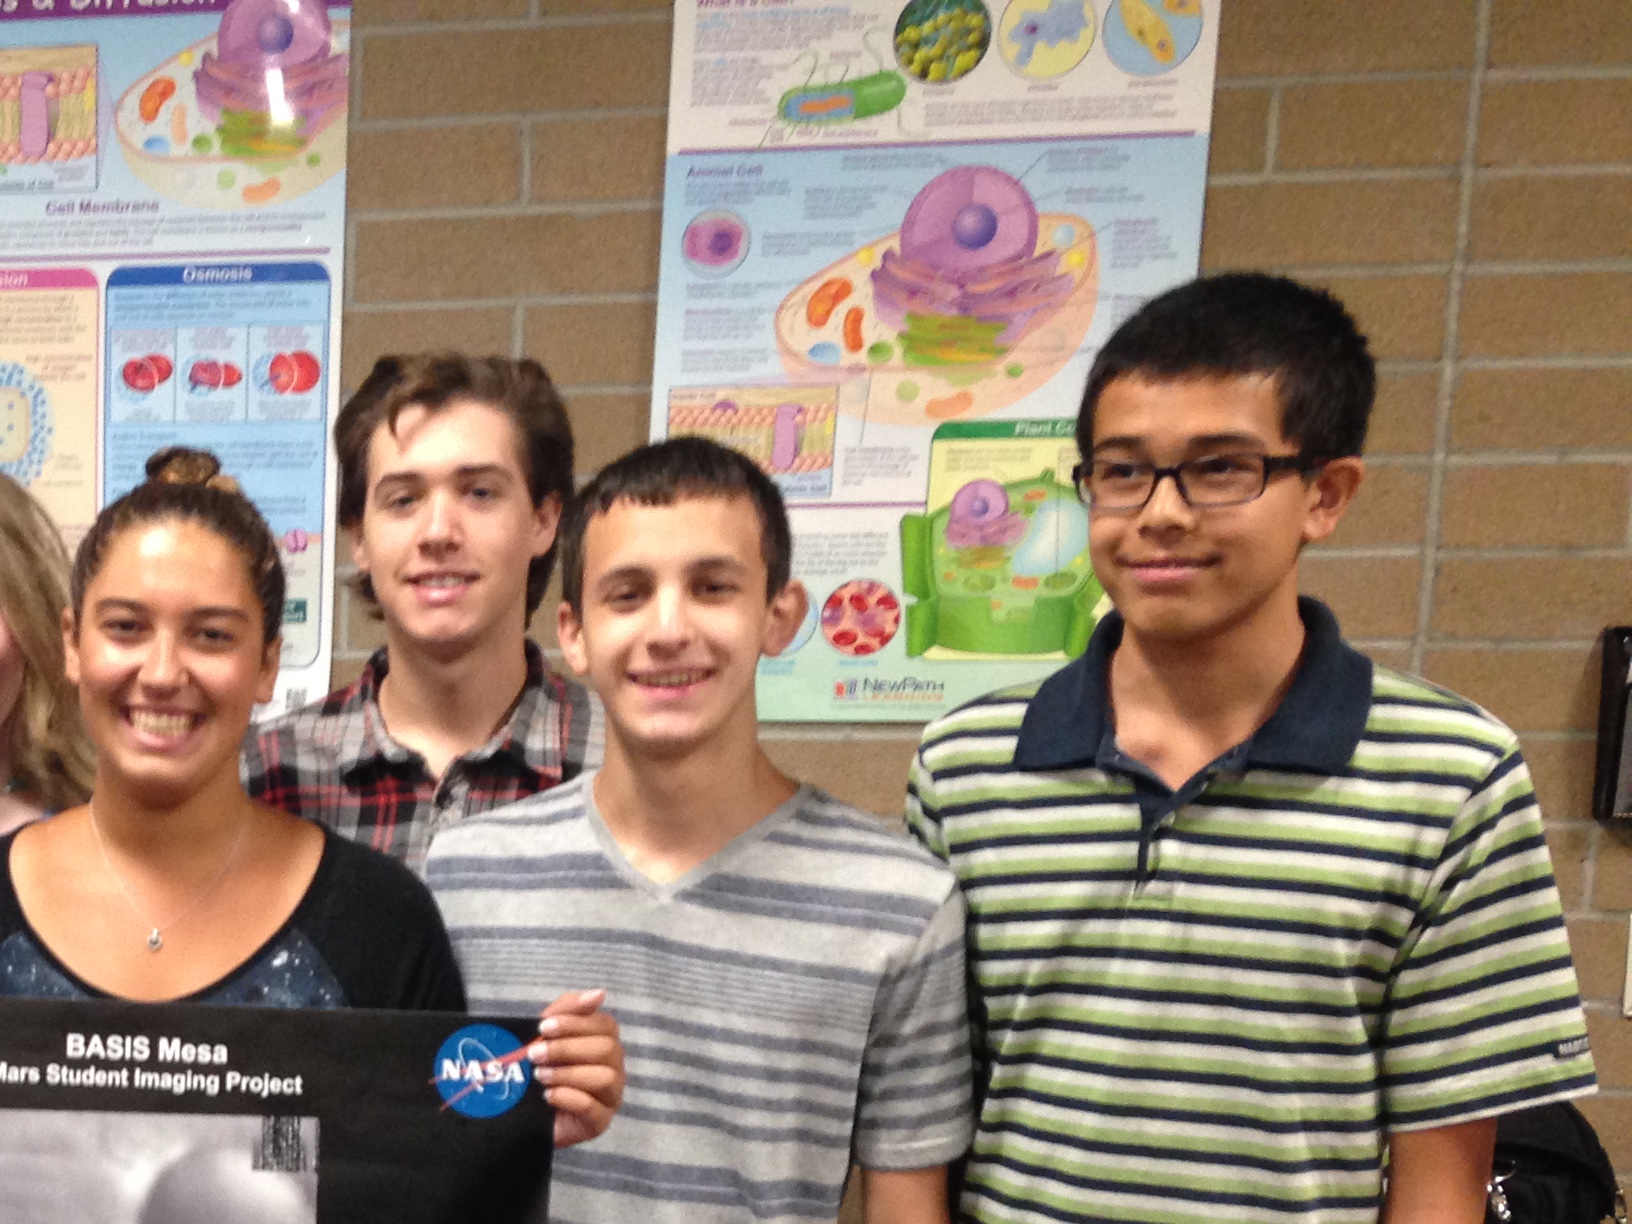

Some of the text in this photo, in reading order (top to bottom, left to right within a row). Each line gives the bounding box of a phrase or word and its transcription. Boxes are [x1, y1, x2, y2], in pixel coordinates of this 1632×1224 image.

[46, 199, 159, 216] Cell Membrane
[183, 264, 253, 284] Osmosis
[66, 1033, 229, 1065] BASIS Mesa
[46, 1062, 130, 1089] Student
[133, 1066, 220, 1097] Imaging
[226, 1070, 304, 1099] Project
[441, 1058, 526, 1083] NASA
